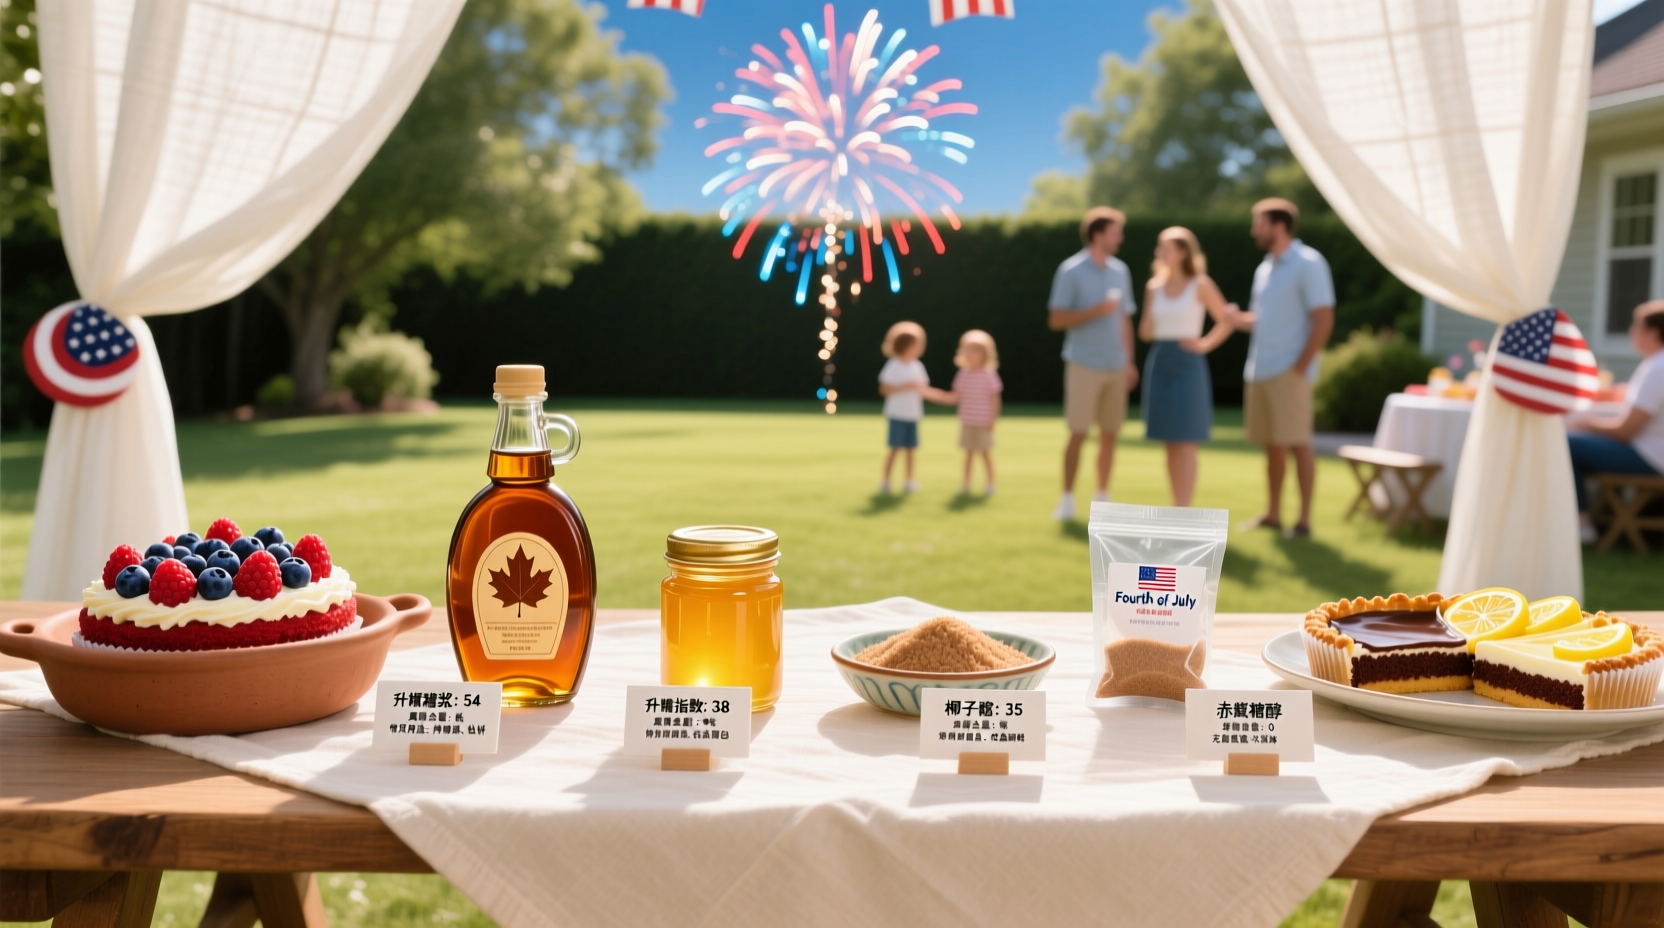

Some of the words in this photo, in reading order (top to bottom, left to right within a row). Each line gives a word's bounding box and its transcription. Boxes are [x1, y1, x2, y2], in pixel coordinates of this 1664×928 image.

[1115, 591, 1154, 605] Fourth
[1157, 593, 1170, 607] of
[1172, 594, 1197, 610] July
[463, 693, 481, 707] 54
[711, 700, 730, 713] 38
[1005, 702, 1023, 716] 35
